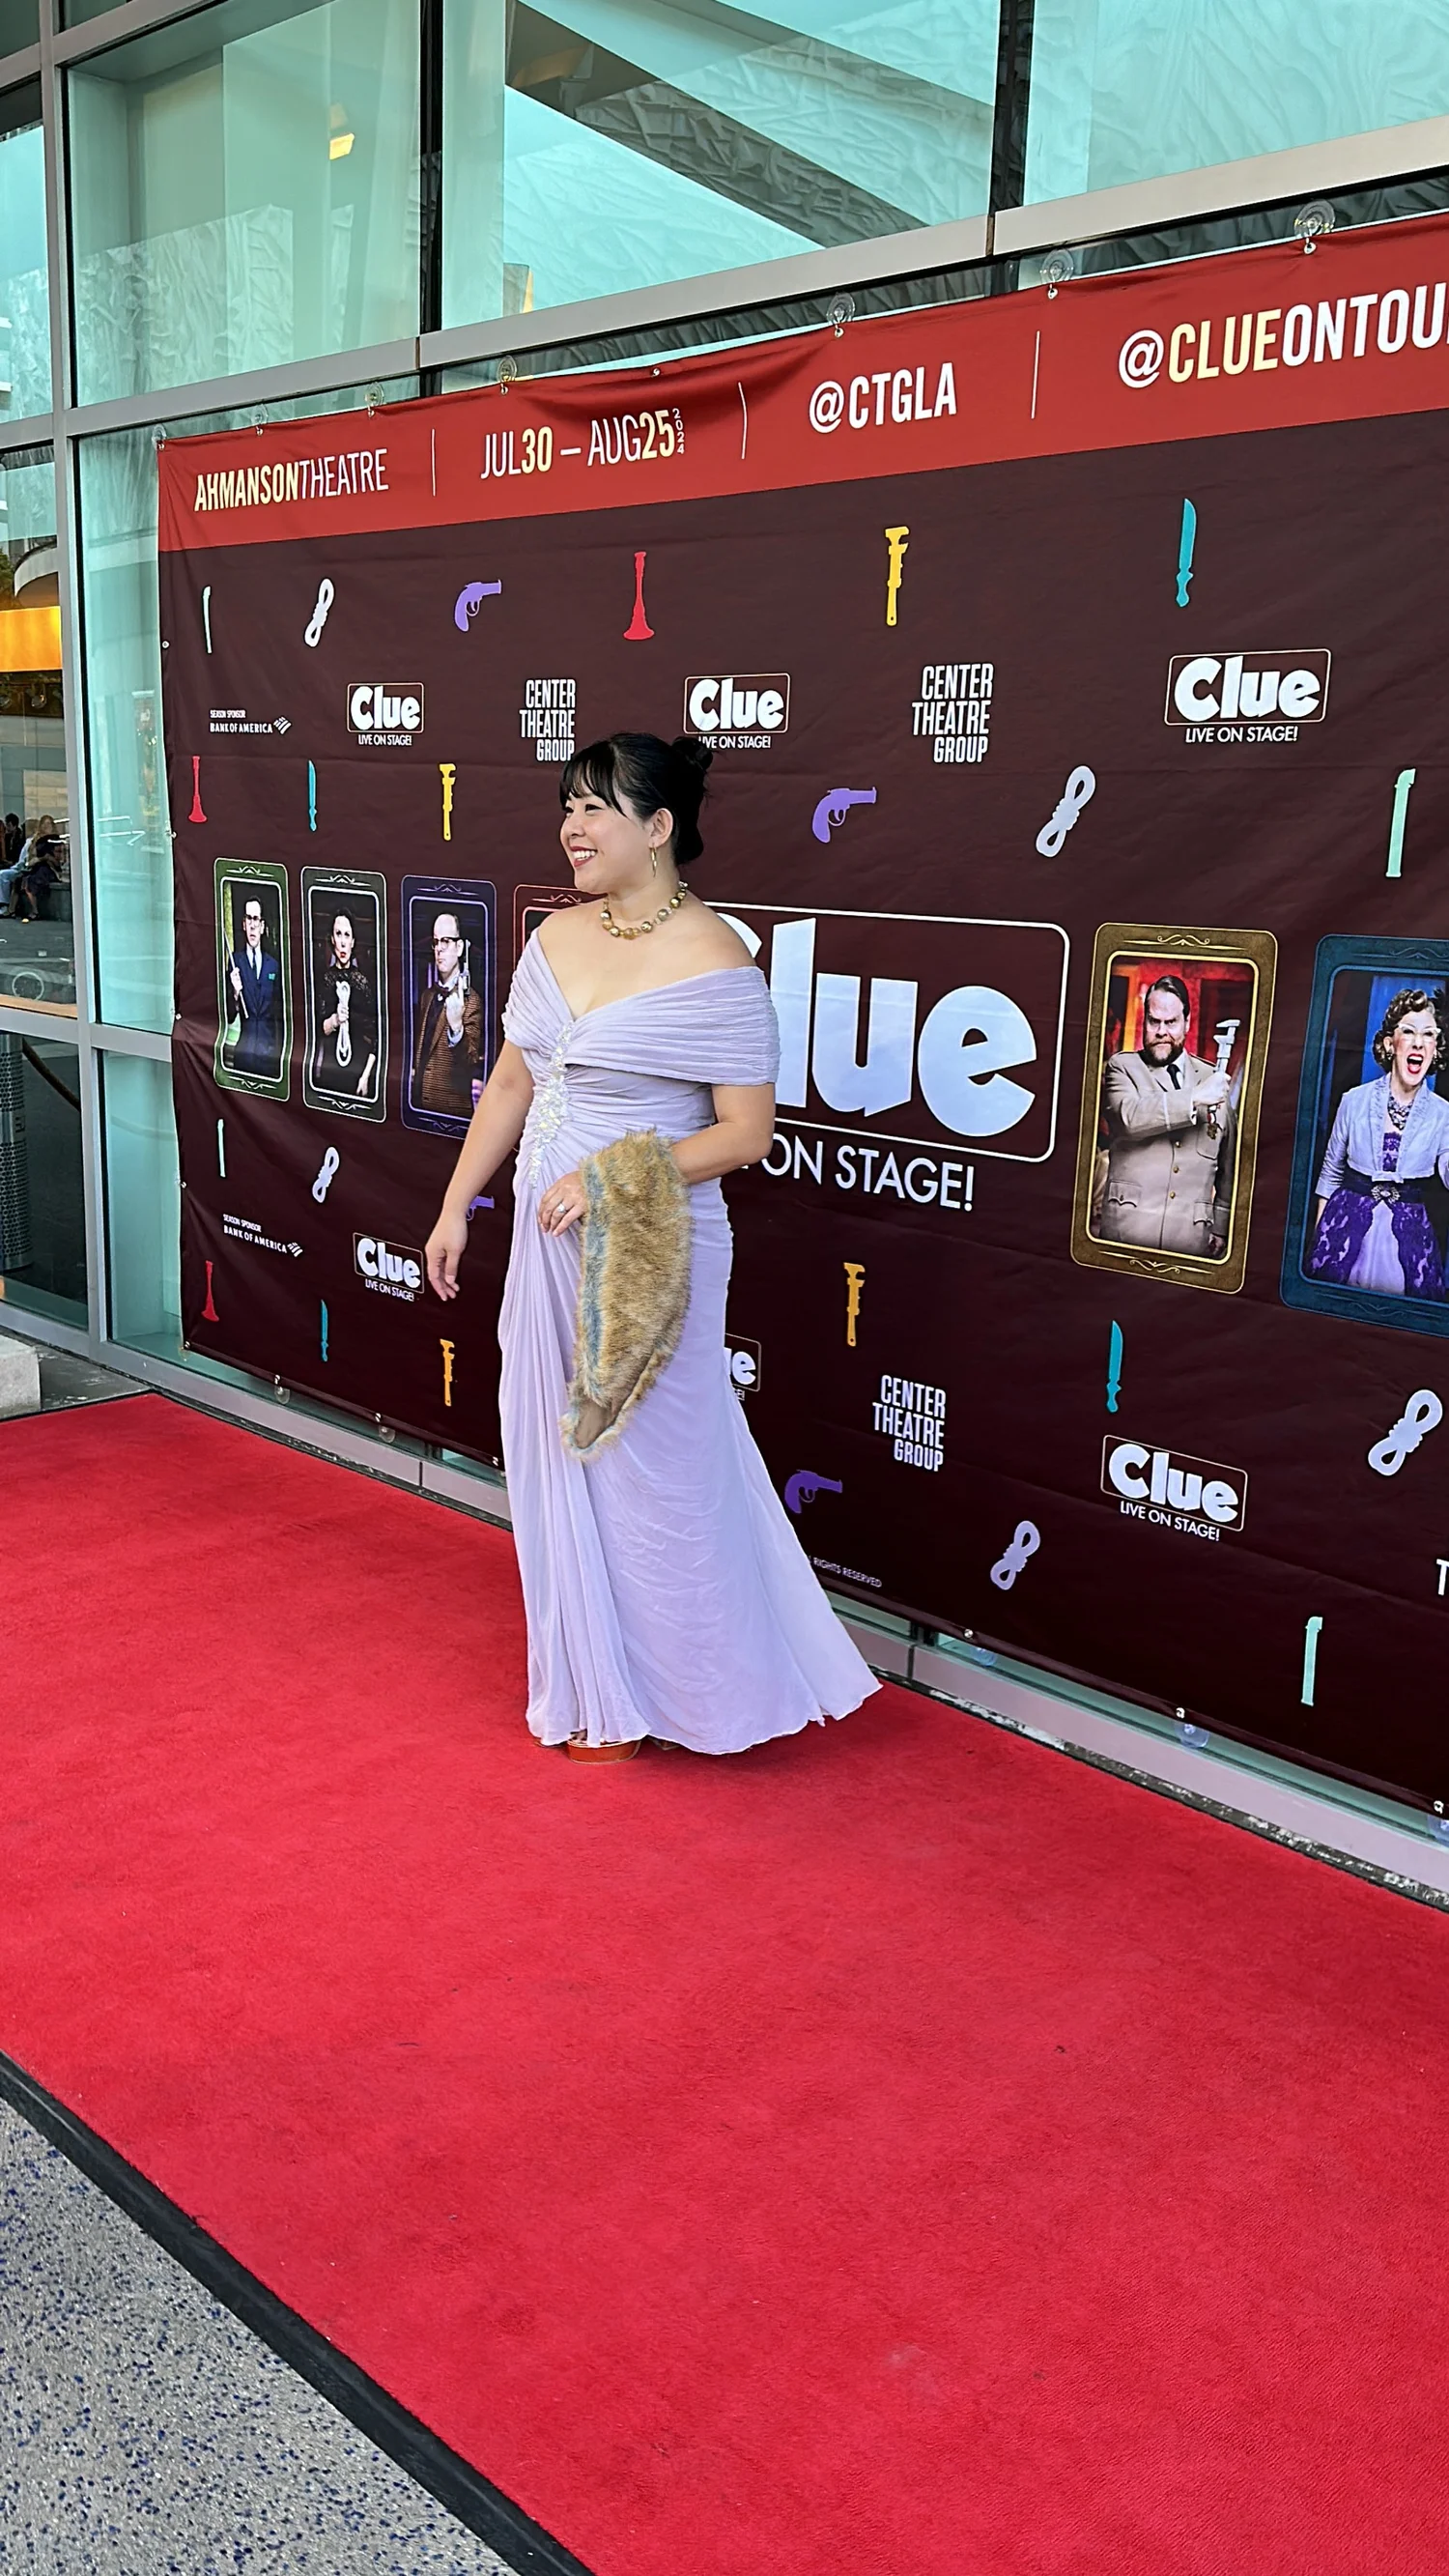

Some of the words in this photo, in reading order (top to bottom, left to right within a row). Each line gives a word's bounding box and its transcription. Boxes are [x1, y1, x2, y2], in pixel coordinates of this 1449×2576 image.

[1118, 282, 1449, 388] @CLUEONTOU
[809, 362, 957, 434] @CTGLA
[481, 426, 554, 479] JUL30
[587, 410, 675, 466] AUG25
[672, 408, 685, 454] 2024
[194, 448, 389, 512] AHMANSONTHEATRE
[526, 679, 576, 708] CENTER
[922, 663, 994, 700] CENTER
[1175, 655, 1321, 722] Clue
[351, 685, 420, 730] Clue
[520, 709, 576, 738] THEATRE
[689, 678, 784, 731] Clue
[912, 701, 992, 735] THEATRE
[210, 723, 229, 732] BANK
[229, 723, 239, 732] OF
[239, 723, 273, 733] AMERICA
[358, 734, 373, 745] LIVE
[374, 734, 386, 745] ON
[719, 735, 736, 748] ON
[737, 735, 771, 748] STAGE!
[1185, 727, 1214, 743] LIVE
[1217, 727, 1243, 742] ON
[1246, 726, 1298, 742] STAGE!
[536, 739, 575, 761] GROUP
[933, 736, 988, 762] GROUP
[716, 913, 1037, 1137] lue
[761, 1132, 823, 1185] ON
[836, 1145, 975, 1212] STAGE!
[223, 1224, 243, 1239] BANK
[243, 1231, 253, 1242] OF
[254, 1235, 288, 1254] AMERICA
[356, 1238, 421, 1288] Clue
[365, 1278, 379, 1291] LIVE
[379, 1283, 391, 1295] ON
[880, 1374, 947, 1418] CENTER
[872, 1401, 945, 1449] THEATRE
[894, 1439, 944, 1472] GROUP
[1108, 1443, 1238, 1523] Clue
[1120, 1500, 1146, 1520] LIVE
[1148, 1509, 1172, 1527] ON
[1174, 1517, 1221, 1541] STAGE!
[813, 1557, 841, 1574] RIGHTS
[842, 1567, 882, 1588] RESERVED
